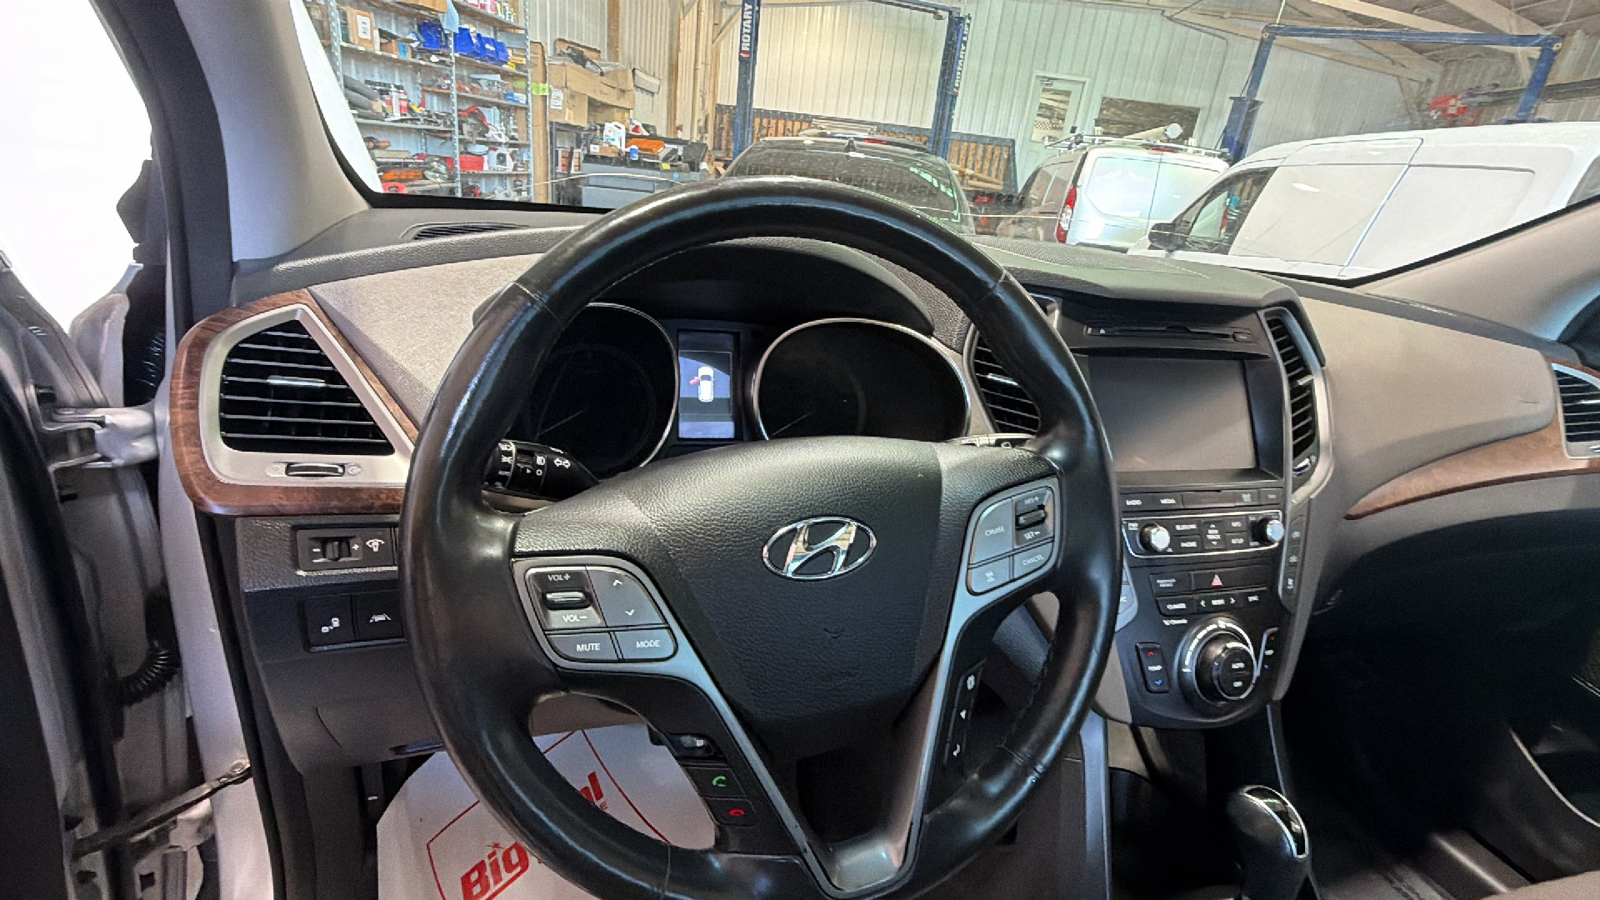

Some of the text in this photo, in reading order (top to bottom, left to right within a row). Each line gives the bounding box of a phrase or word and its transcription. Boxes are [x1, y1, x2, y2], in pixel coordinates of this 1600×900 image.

[741, 2, 753, 51] ROTARY
[576, 642, 601, 652] MUTE
[636, 640, 661, 649] MODE
[460, 841, 530, 900] Big
